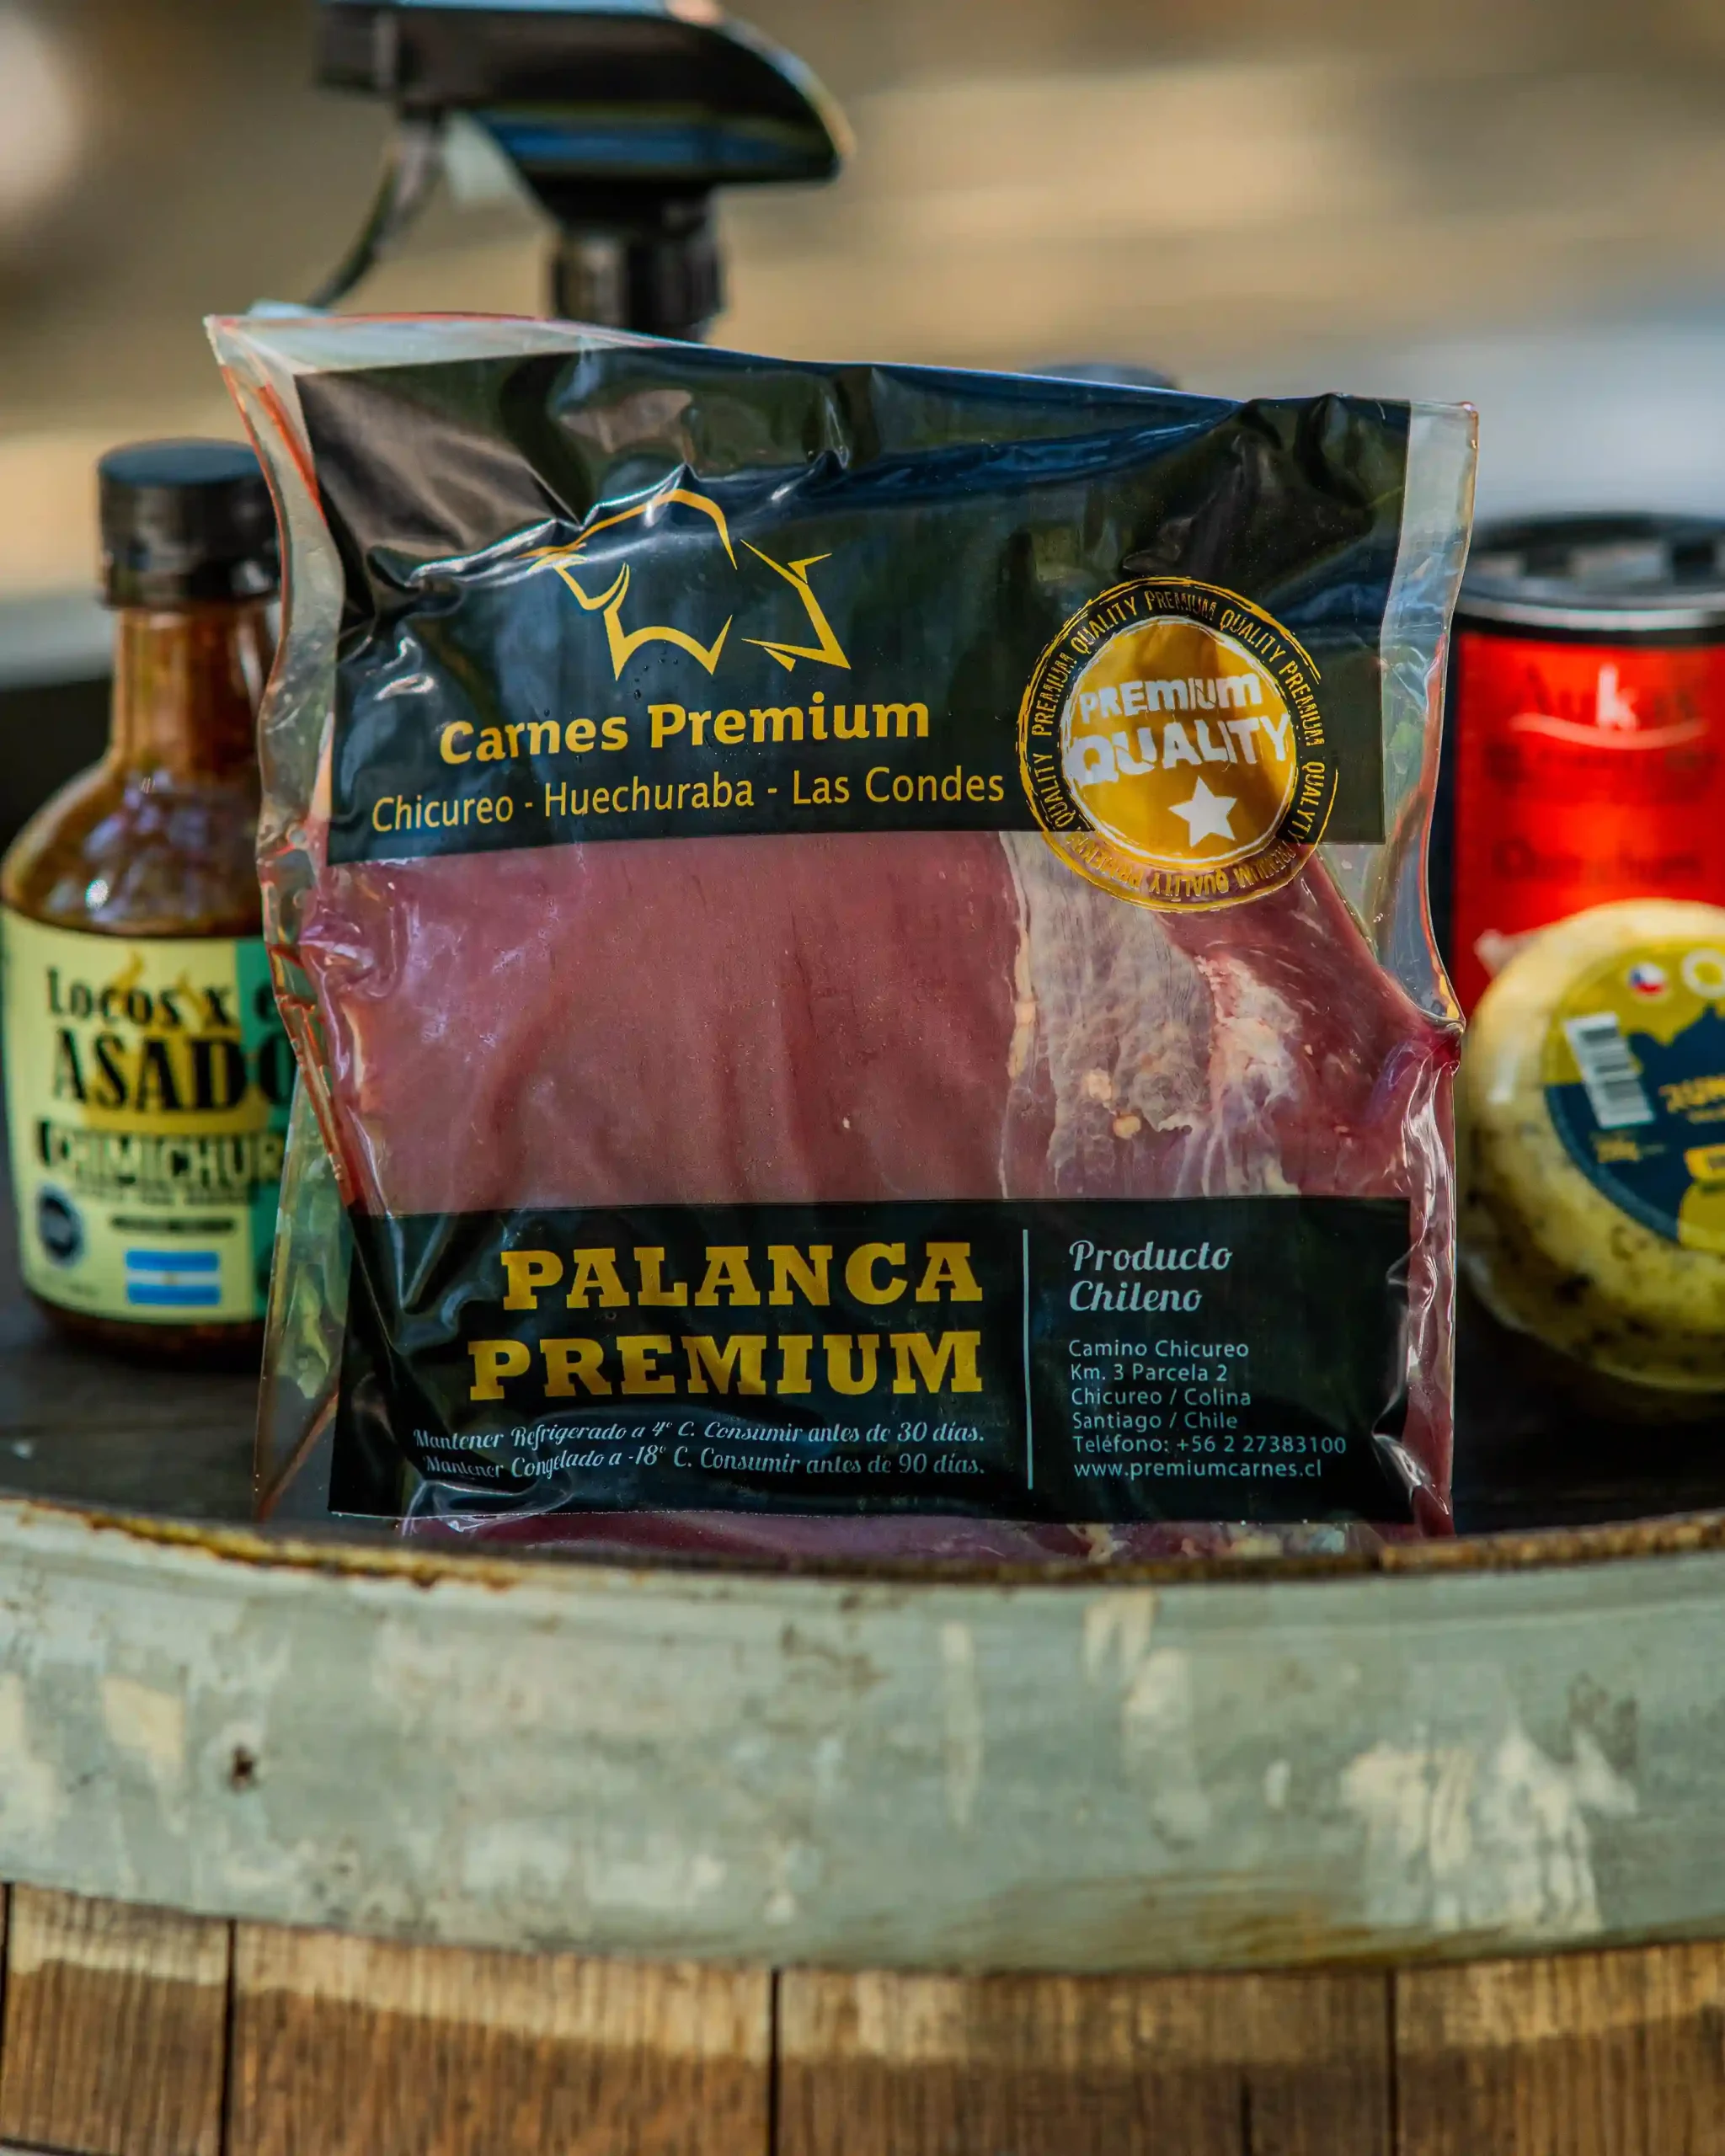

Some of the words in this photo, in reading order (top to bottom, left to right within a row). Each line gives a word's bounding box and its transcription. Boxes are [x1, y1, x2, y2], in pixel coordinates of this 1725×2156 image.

[1071, 595, 1138, 655] QUALITY
[1220, 608, 1286, 664] QUALITY
[1030, 650, 1077, 738] PREMIUM
[1279, 659, 1326, 747] PREMIUM
[441, 716, 628, 764] Carnes
[649, 691, 929, 749] Premium
[1065, 712, 1293, 790] QUALITY
[372, 794, 515, 832] Chicureo
[545, 771, 755, 817] Huechuraba
[793, 770, 850, 804] Las
[865, 765, 1004, 803] Condes
[1028, 751, 1074, 829] QUALITY
[54, 1026, 297, 1112] ASADO
[500, 1242, 983, 1310] PALANCA
[1069, 1240, 1233, 1272] Producto
[1070, 1280, 1203, 1312] Chileno
[468, 1330, 983, 1401] PREMIUM
[1069, 1339, 1147, 1357] Camino
[1155, 1339, 1249, 1358] Chicureo
[1071, 1364, 1106, 1380] Km.
[1114, 1363, 1124, 1380] 3
[1132, 1363, 1209, 1382] Parcela
[1216, 1364, 1227, 1382] 2
[1071, 1386, 1162, 1406] Chicureo
[1184, 1387, 1251, 1406] Colina
[1072, 1412, 1162, 1433] Santiago
[1184, 1412, 1238, 1429] Chile
[414, 1428, 505, 1450] Mantener
[510, 1423, 628, 1451] Refrigerado
[631, 1427, 644, 1438] a
[677, 1421, 695, 1437] C.
[704, 1421, 804, 1443] Consumir
[808, 1423, 860, 1443] antes
[866, 1423, 891, 1443] de
[897, 1422, 927, 1442] 30
[932, 1421, 984, 1442] días.
[423, 1454, 504, 1478] Mantener
[510, 1449, 605, 1480] Congelado
[608, 1452, 622, 1465] a
[673, 1445, 692, 1467] C.
[700, 1447, 801, 1474] Consumir
[806, 1455, 862, 1474] antes
[868, 1454, 891, 1473] de
[899, 1453, 927, 1473] 90
[933, 1453, 985, 1474] días.
[1071, 1433, 1172, 1454] Teléfono:
[1176, 1435, 1216, 1454] +56
[1224, 1435, 1235, 1453] 2
[1242, 1435, 1346, 1454] 27383100
[1073, 1459, 1322, 1481] www.premiumcarnes.cl
